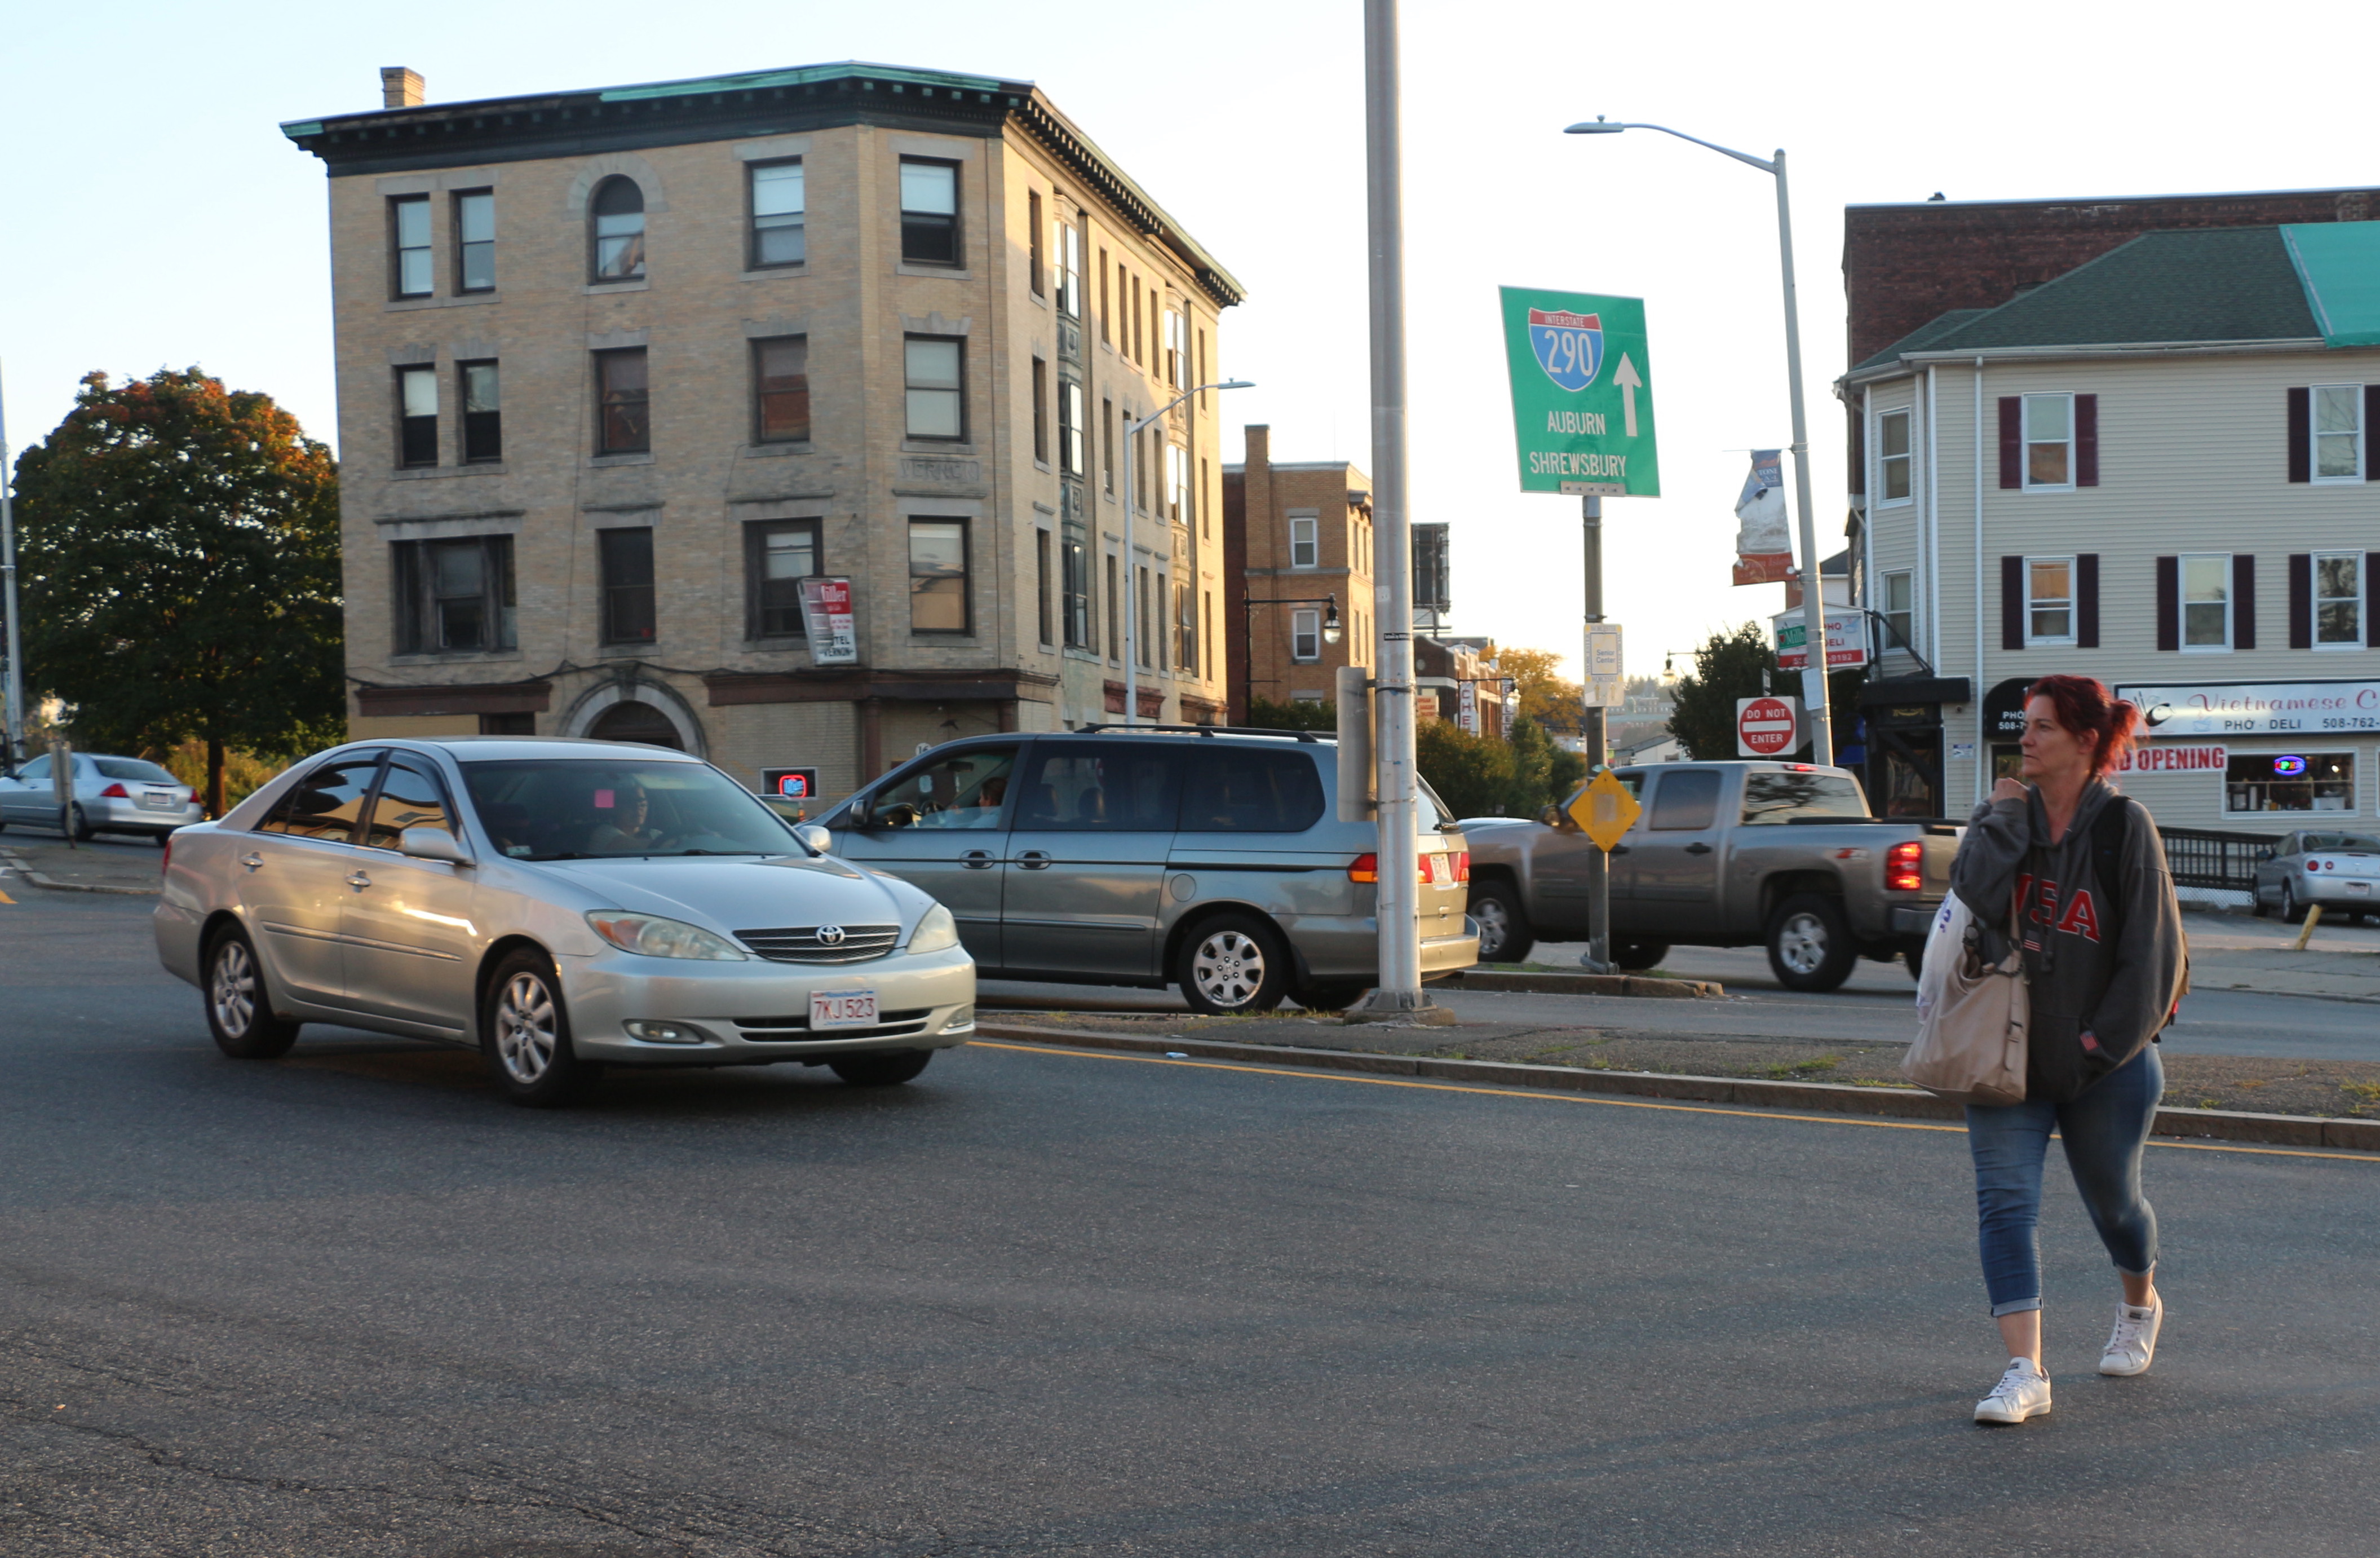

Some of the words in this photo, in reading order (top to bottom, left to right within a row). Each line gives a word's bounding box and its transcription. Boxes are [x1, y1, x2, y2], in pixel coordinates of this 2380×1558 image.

[1545, 314, 1585, 328] INTERSTATE
[1544, 329, 1594, 377] 290
[1547, 411, 1606, 435] AUBURN
[1529, 451, 1626, 477] SHREWSBURY
[2188, 694, 2347, 712] Vietnamese
[1746, 709, 1762, 719] DO
[1766, 708, 1786, 718] NOT
[2269, 719, 2301, 729] DELI
[2323, 717, 2380, 727] 508-762-
[1751, 733, 1784, 744] ENTER
[2138, 747, 2224, 771] OPENING
